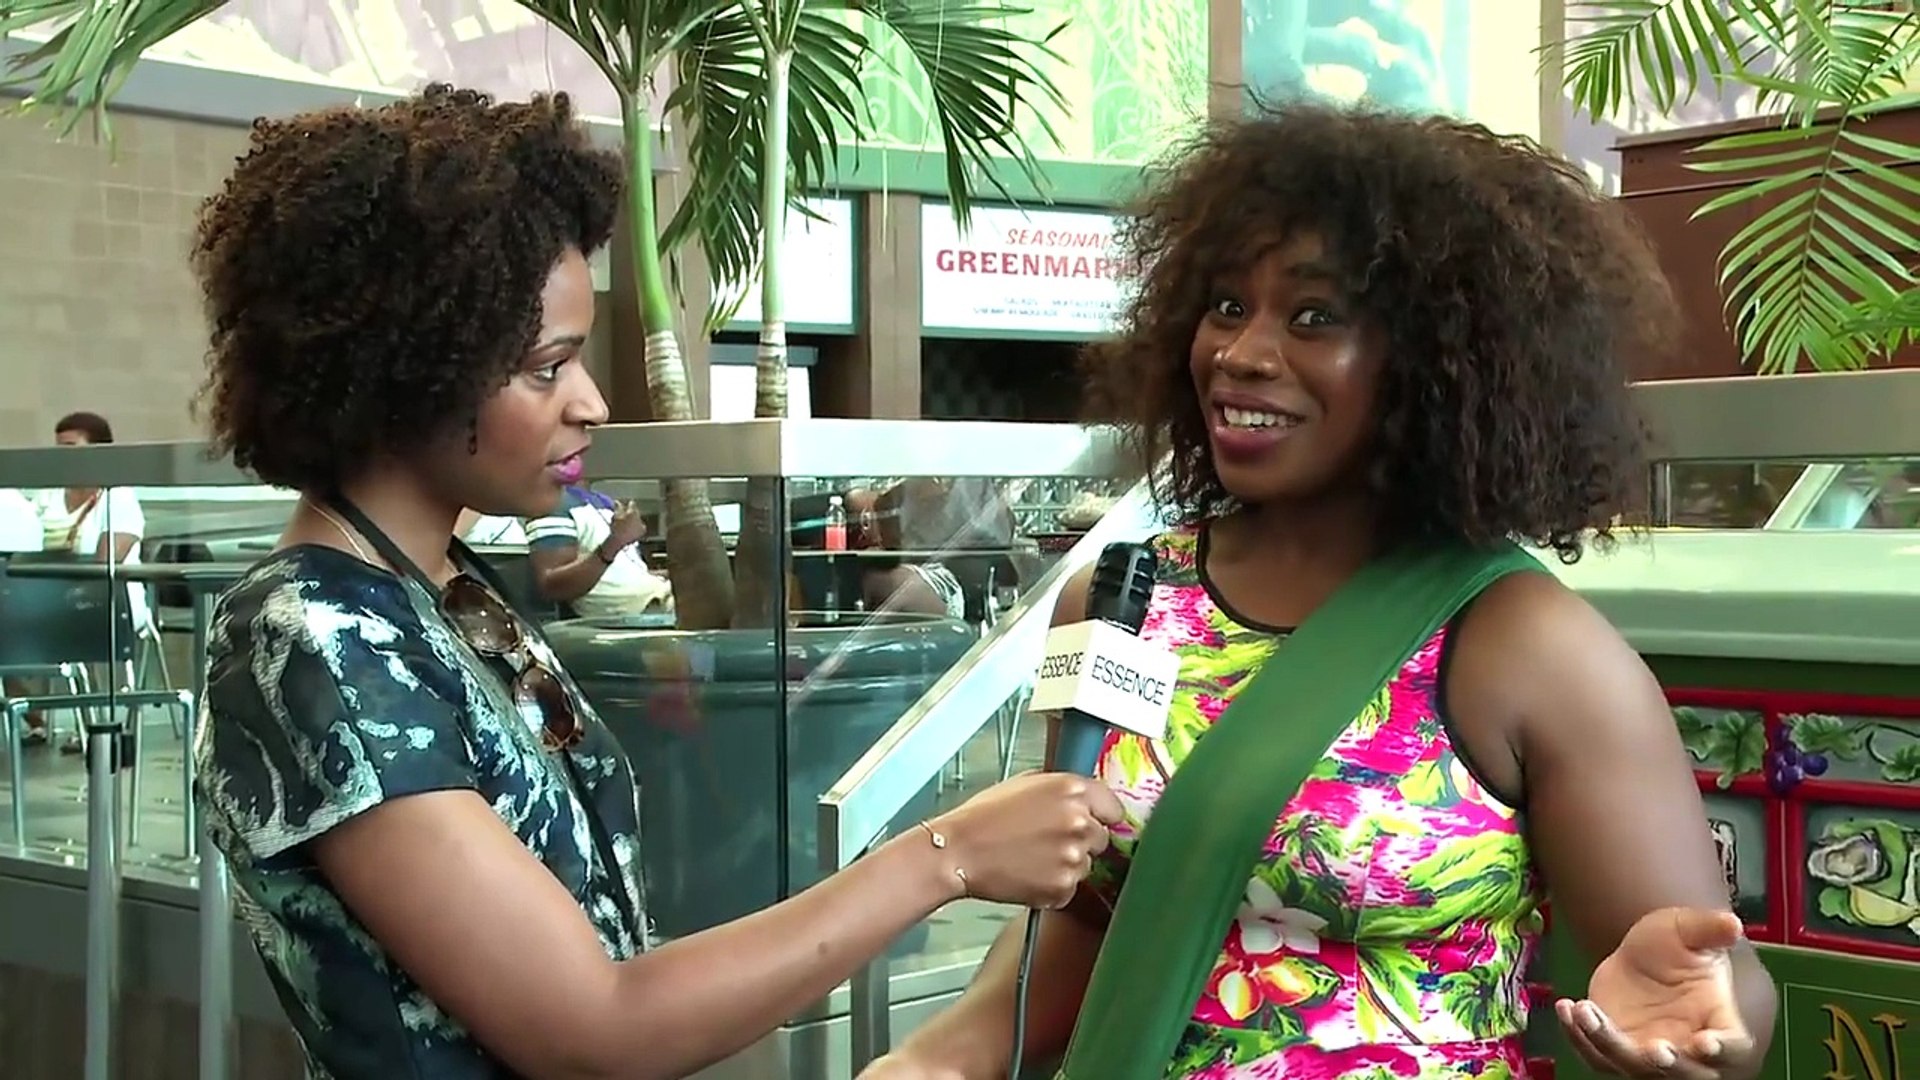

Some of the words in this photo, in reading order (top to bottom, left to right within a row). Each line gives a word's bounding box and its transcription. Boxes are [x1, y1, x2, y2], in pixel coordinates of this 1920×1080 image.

[935, 249, 1134, 280] GREENMAR
[1040, 651, 1084, 680] ESSENCE
[1091, 654, 1167, 706] ESSENCE
[1820, 1004, 1907, 1080] N
